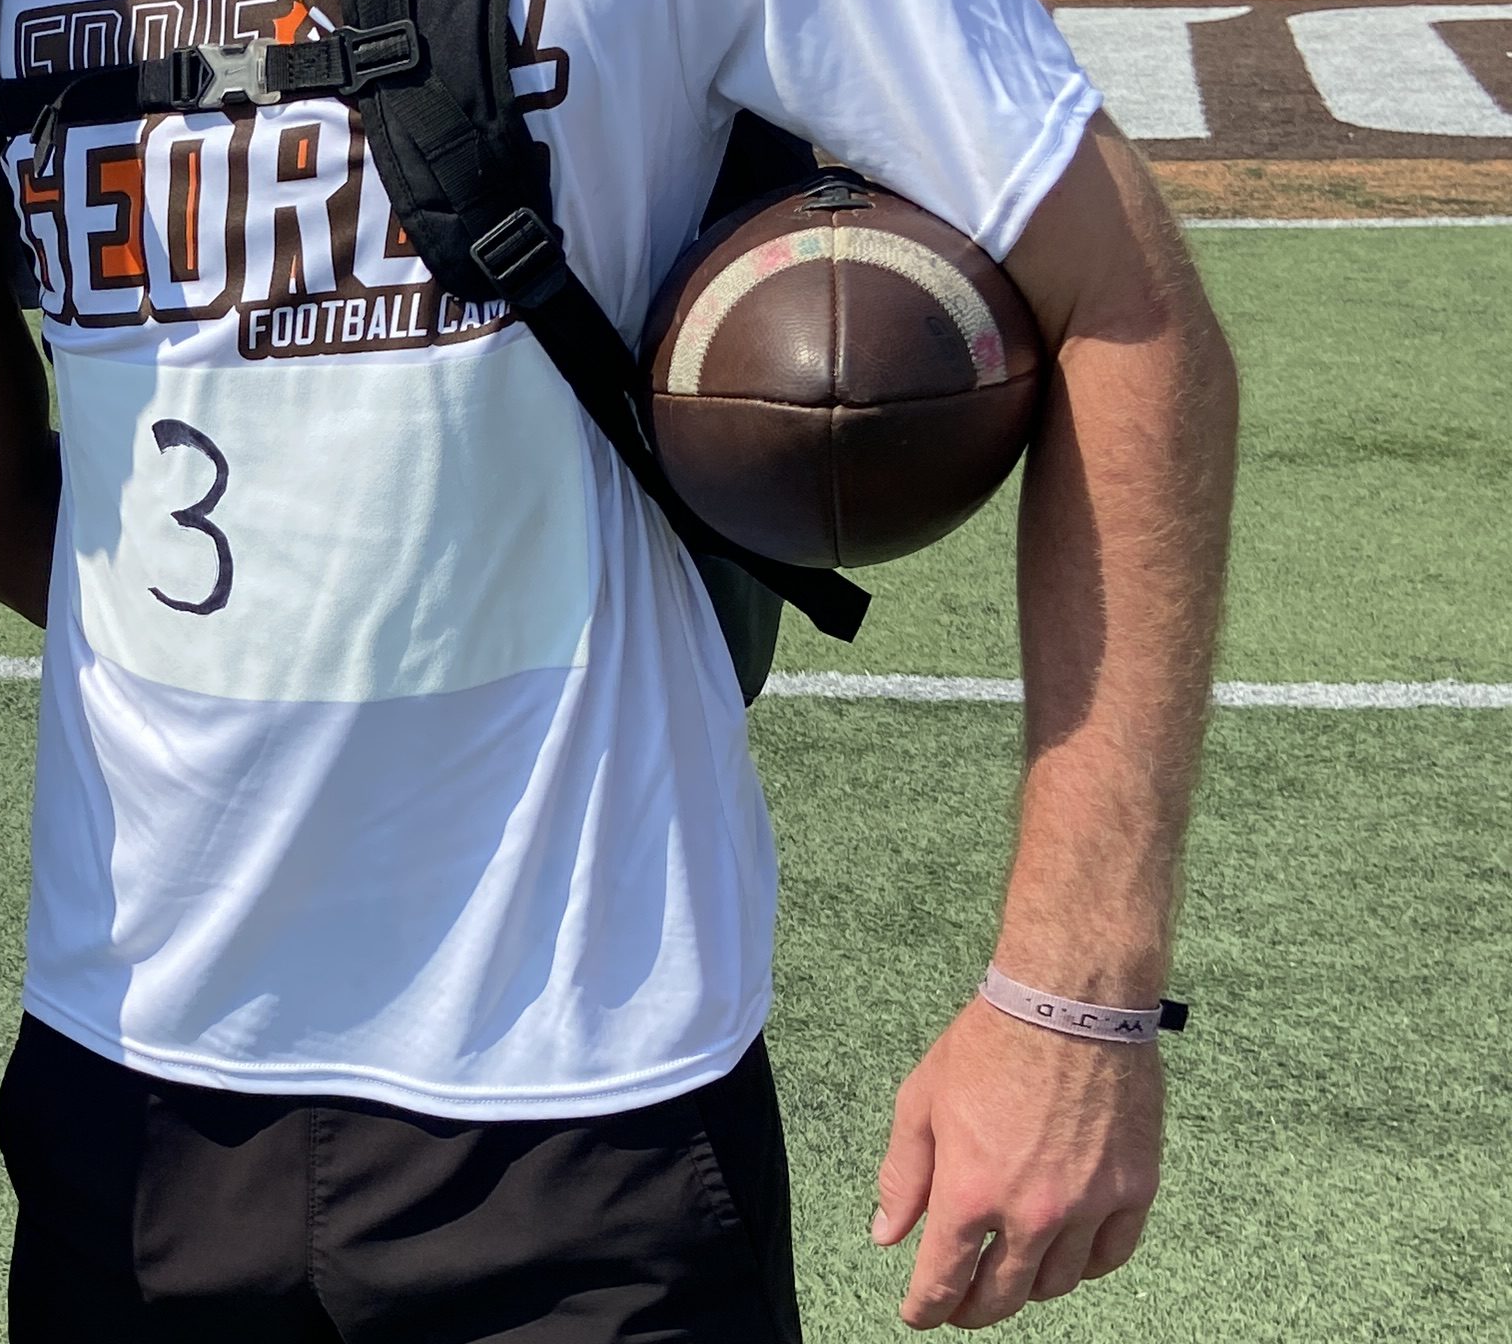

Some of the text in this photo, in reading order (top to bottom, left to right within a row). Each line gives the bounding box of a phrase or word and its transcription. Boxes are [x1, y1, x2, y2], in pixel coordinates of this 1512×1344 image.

[2, 92, 438, 318] GEOR
[248, 292, 510, 351] FOOTBALL CAM
[147, 418, 235, 616] 3
